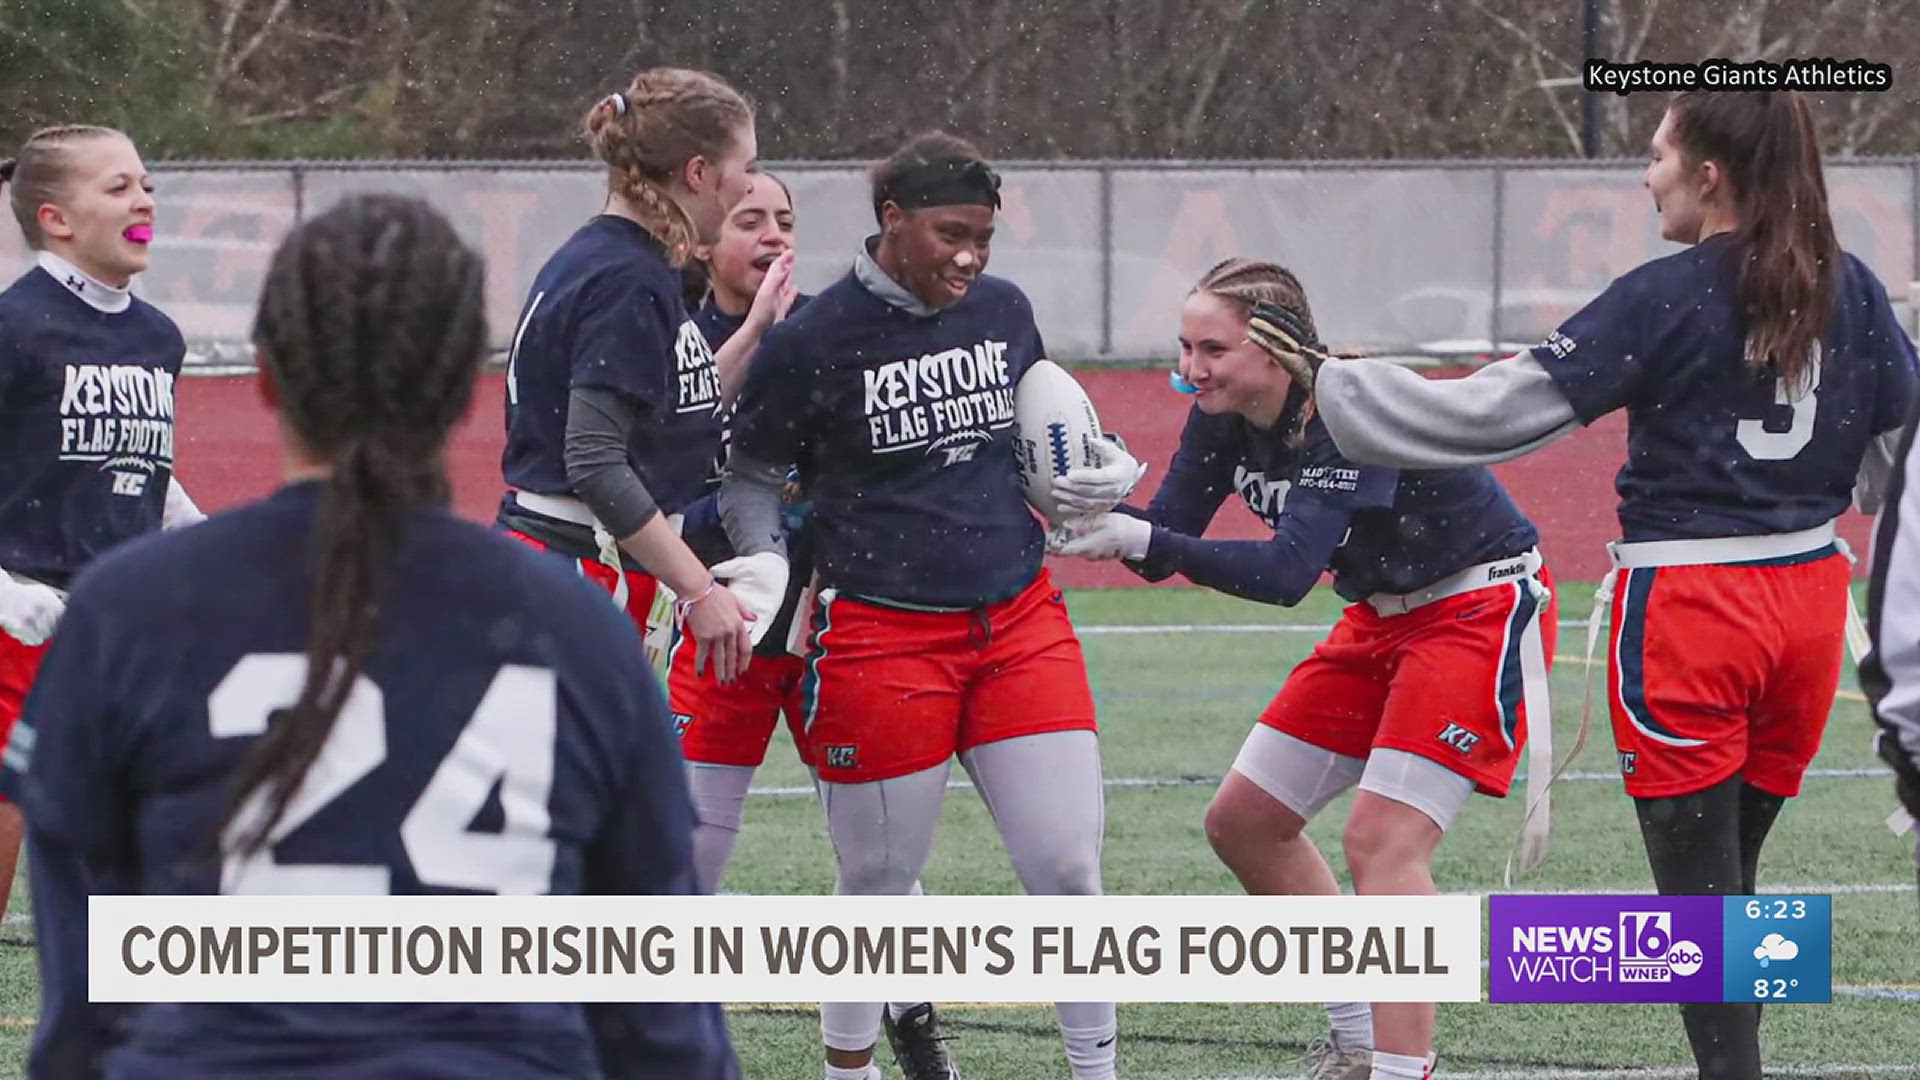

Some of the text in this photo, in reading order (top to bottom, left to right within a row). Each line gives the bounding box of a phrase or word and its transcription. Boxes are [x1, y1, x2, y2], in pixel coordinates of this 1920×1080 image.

[60, 364, 174, 418] KEYSTON
[864, 339, 1009, 415] KEYSTONE
[1735, 337, 1821, 460] 3
[61, 418, 117, 452] FLAG
[869, 405, 929, 447] FLAG
[208, 652, 557, 895] 24
